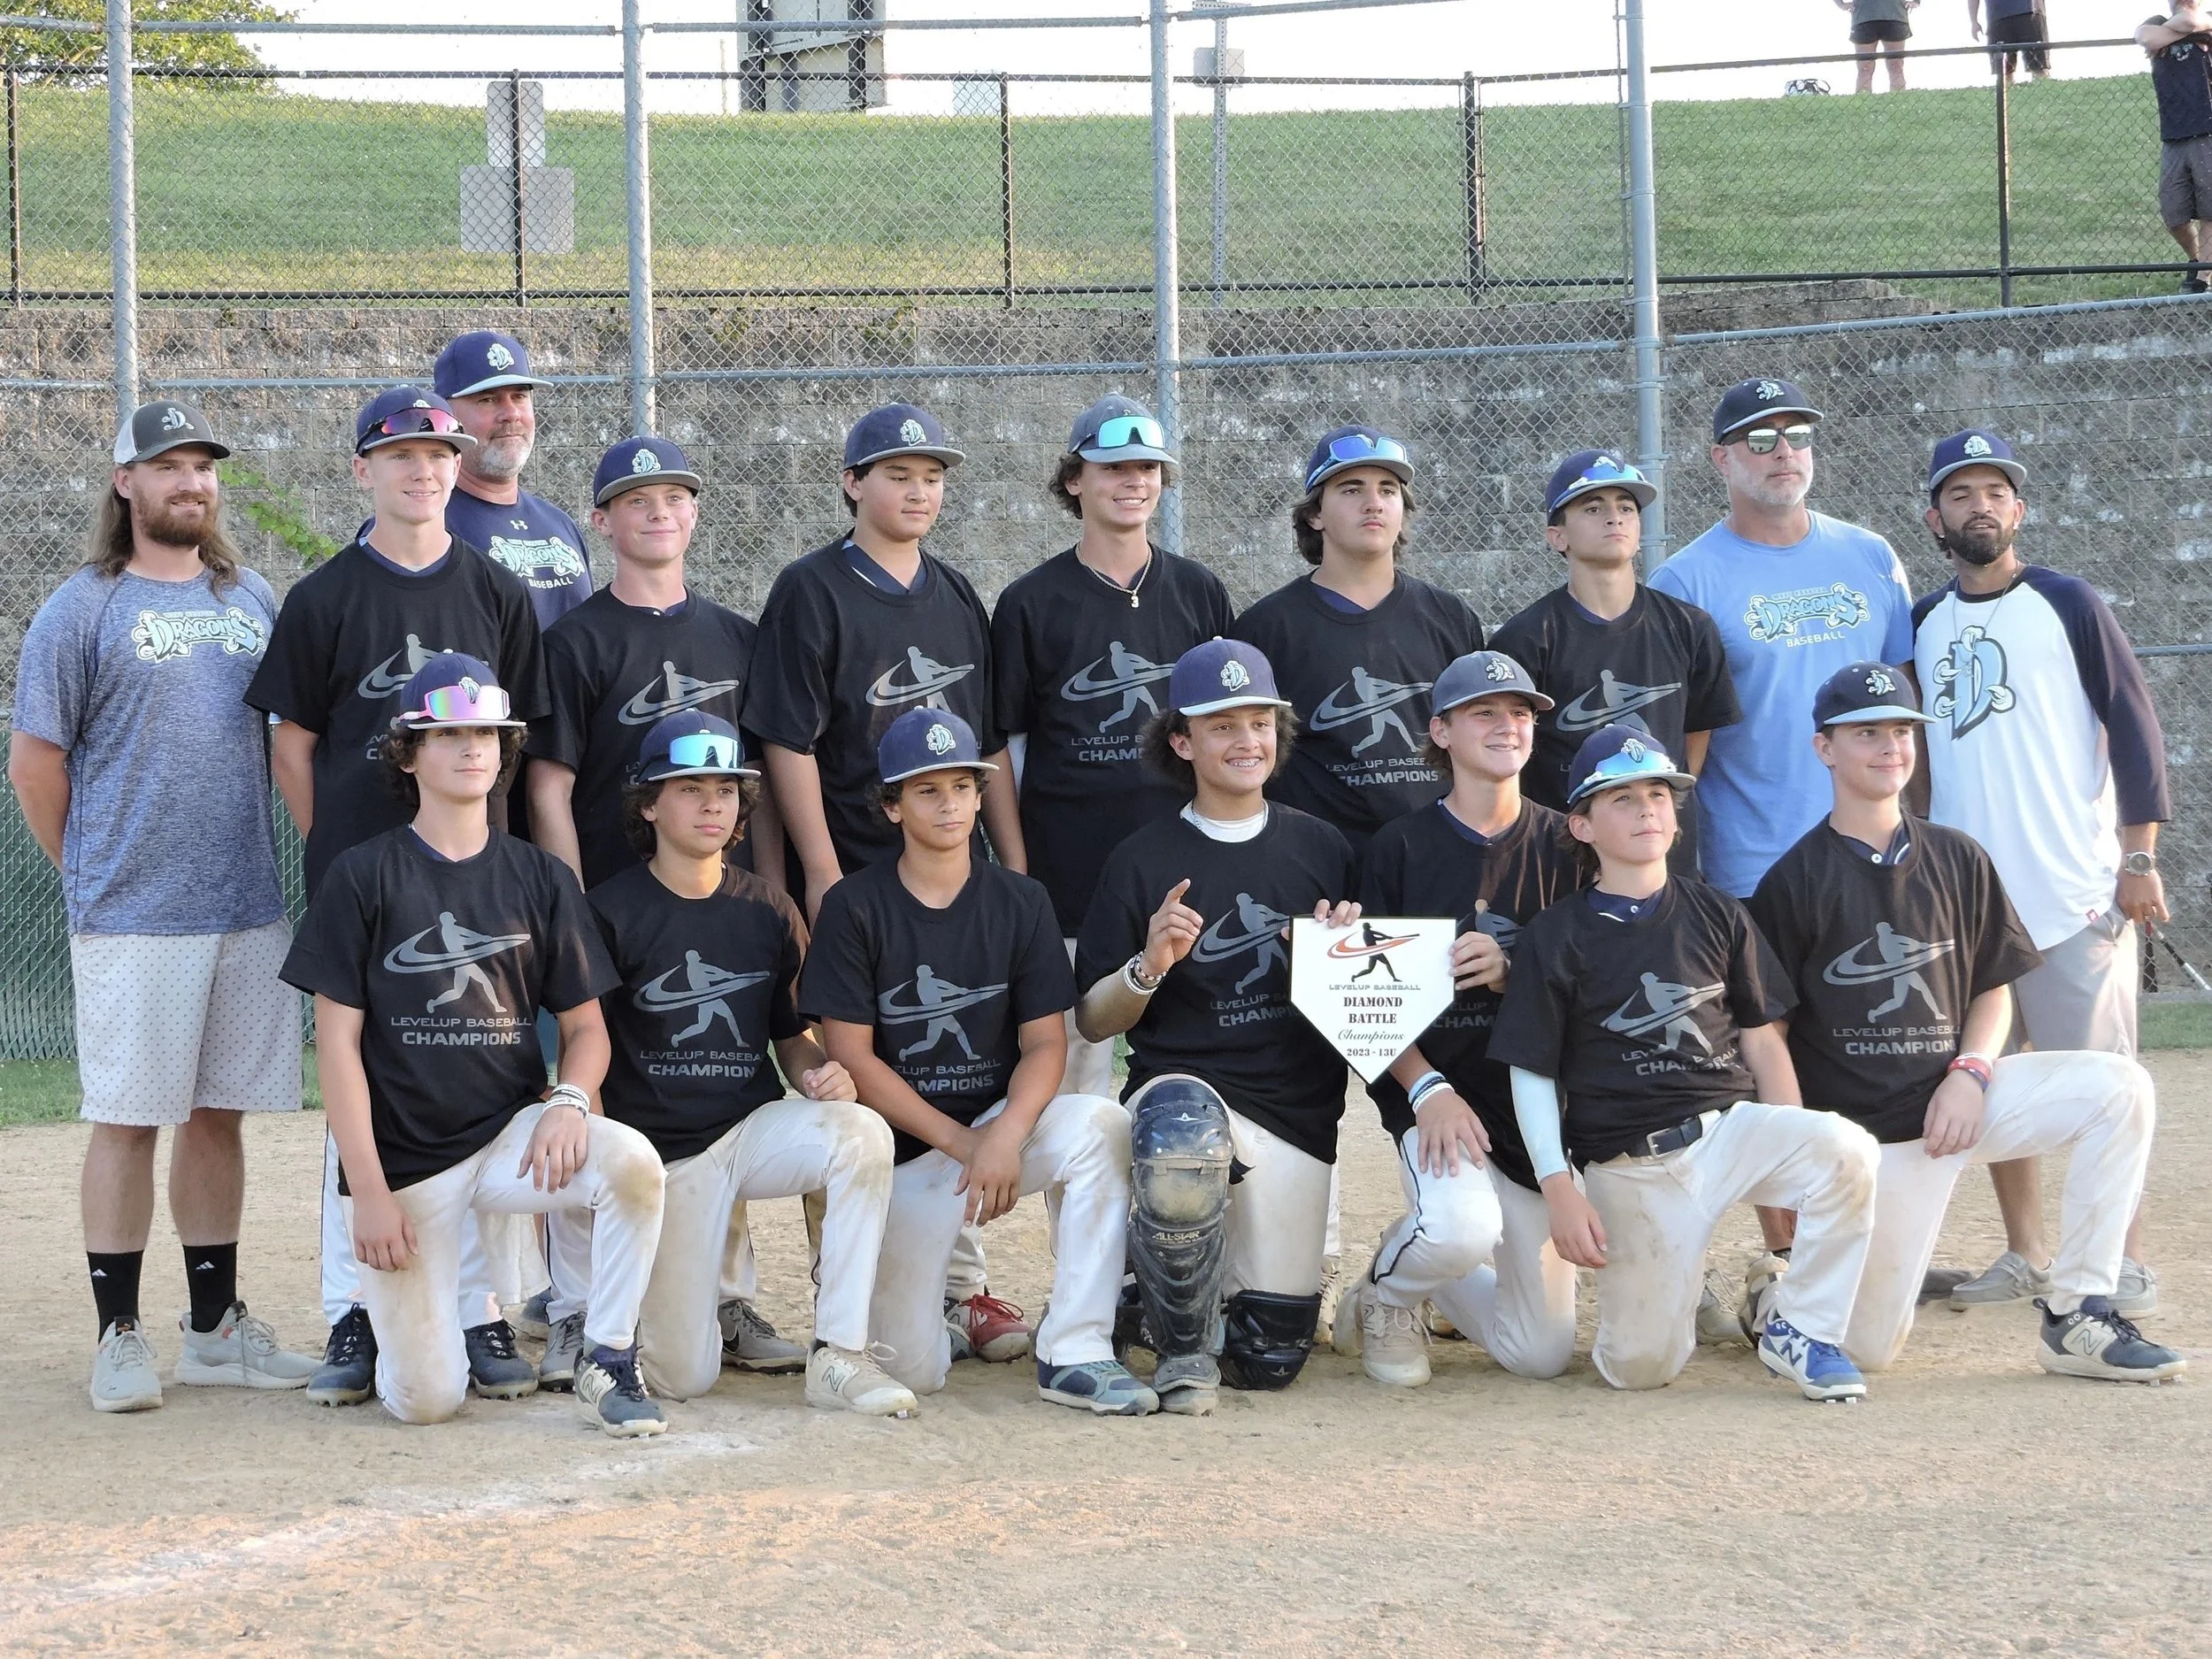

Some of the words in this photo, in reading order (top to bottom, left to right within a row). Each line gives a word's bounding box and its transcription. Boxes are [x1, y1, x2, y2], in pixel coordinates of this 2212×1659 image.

[528, 576, 573, 588] BASEBALL
[1744, 582, 1870, 642] DRAGONS
[133, 607, 265, 663] DRAGONS
[1786, 631, 1845, 648] BASEBALL
[1071, 735, 1129, 746] LEVELUP
[1210, 994, 1269, 1010] LEVELUP
[1343, 996, 1402, 1007] DIAMOND
[391, 1017, 460, 1027] LEVELUP
[466, 1018, 532, 1027] BASEBALL
[1348, 1013, 1397, 1024] BATTLE
[1338, 1028, 1403, 1044] Champions
[1833, 1026, 1902, 1037] LEVELUP
[402, 1031, 521, 1046] CHAMPIONS
[1347, 1048, 1371, 1056] 2023
[1379, 1048, 1396, 1056] 13U
[1845, 1039, 1956, 1055] CHAMPION
[640, 1050, 704, 1060] LEVELUP
[710, 1051, 762, 1062] BASEBA
[648, 1064, 755, 1078] CHAMPION
[936, 1058, 1001, 1075] BASEBALL
[1152, 1230, 1200, 1240] ALL-STAR
